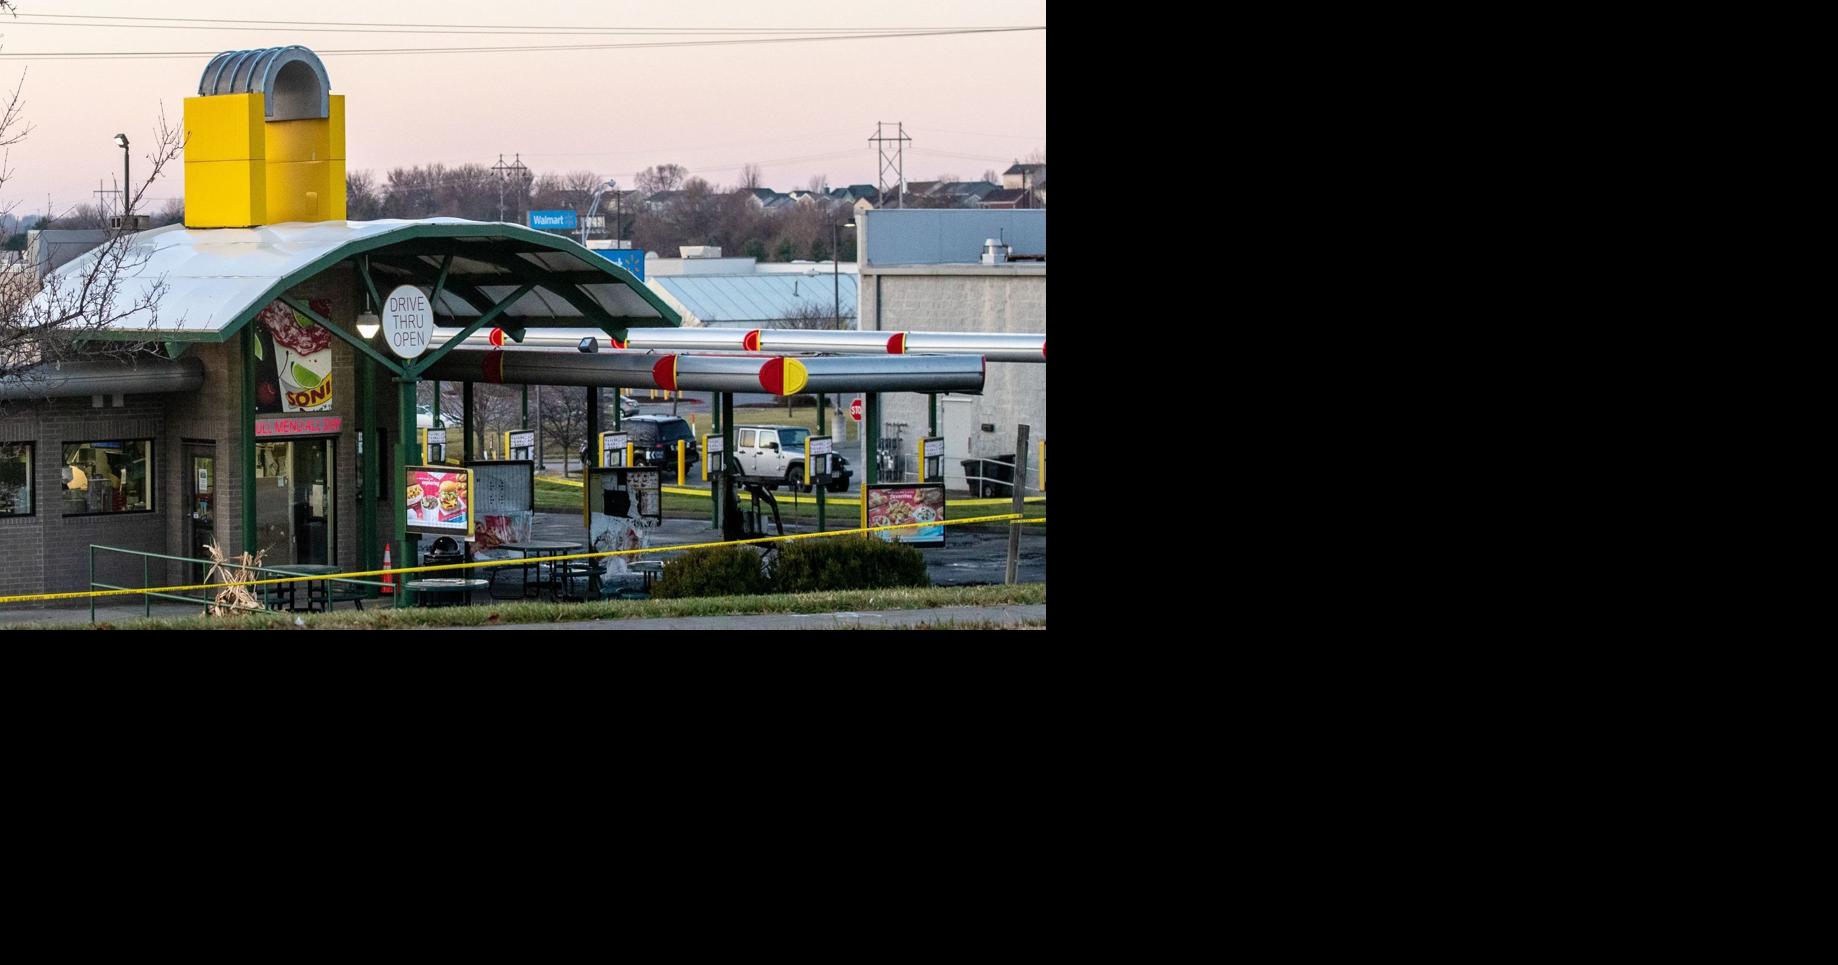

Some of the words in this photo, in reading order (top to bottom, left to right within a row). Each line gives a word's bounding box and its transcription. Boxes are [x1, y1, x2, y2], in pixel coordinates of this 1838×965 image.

[533, 215, 564, 225] Walmart
[390, 296, 424, 312] DRIVE
[392, 314, 424, 329] THRU
[393, 331, 424, 347] OPEN
[287, 380, 331, 406] SONI
[851, 405, 862, 415] STO
[256, 421, 272, 434] ULL
